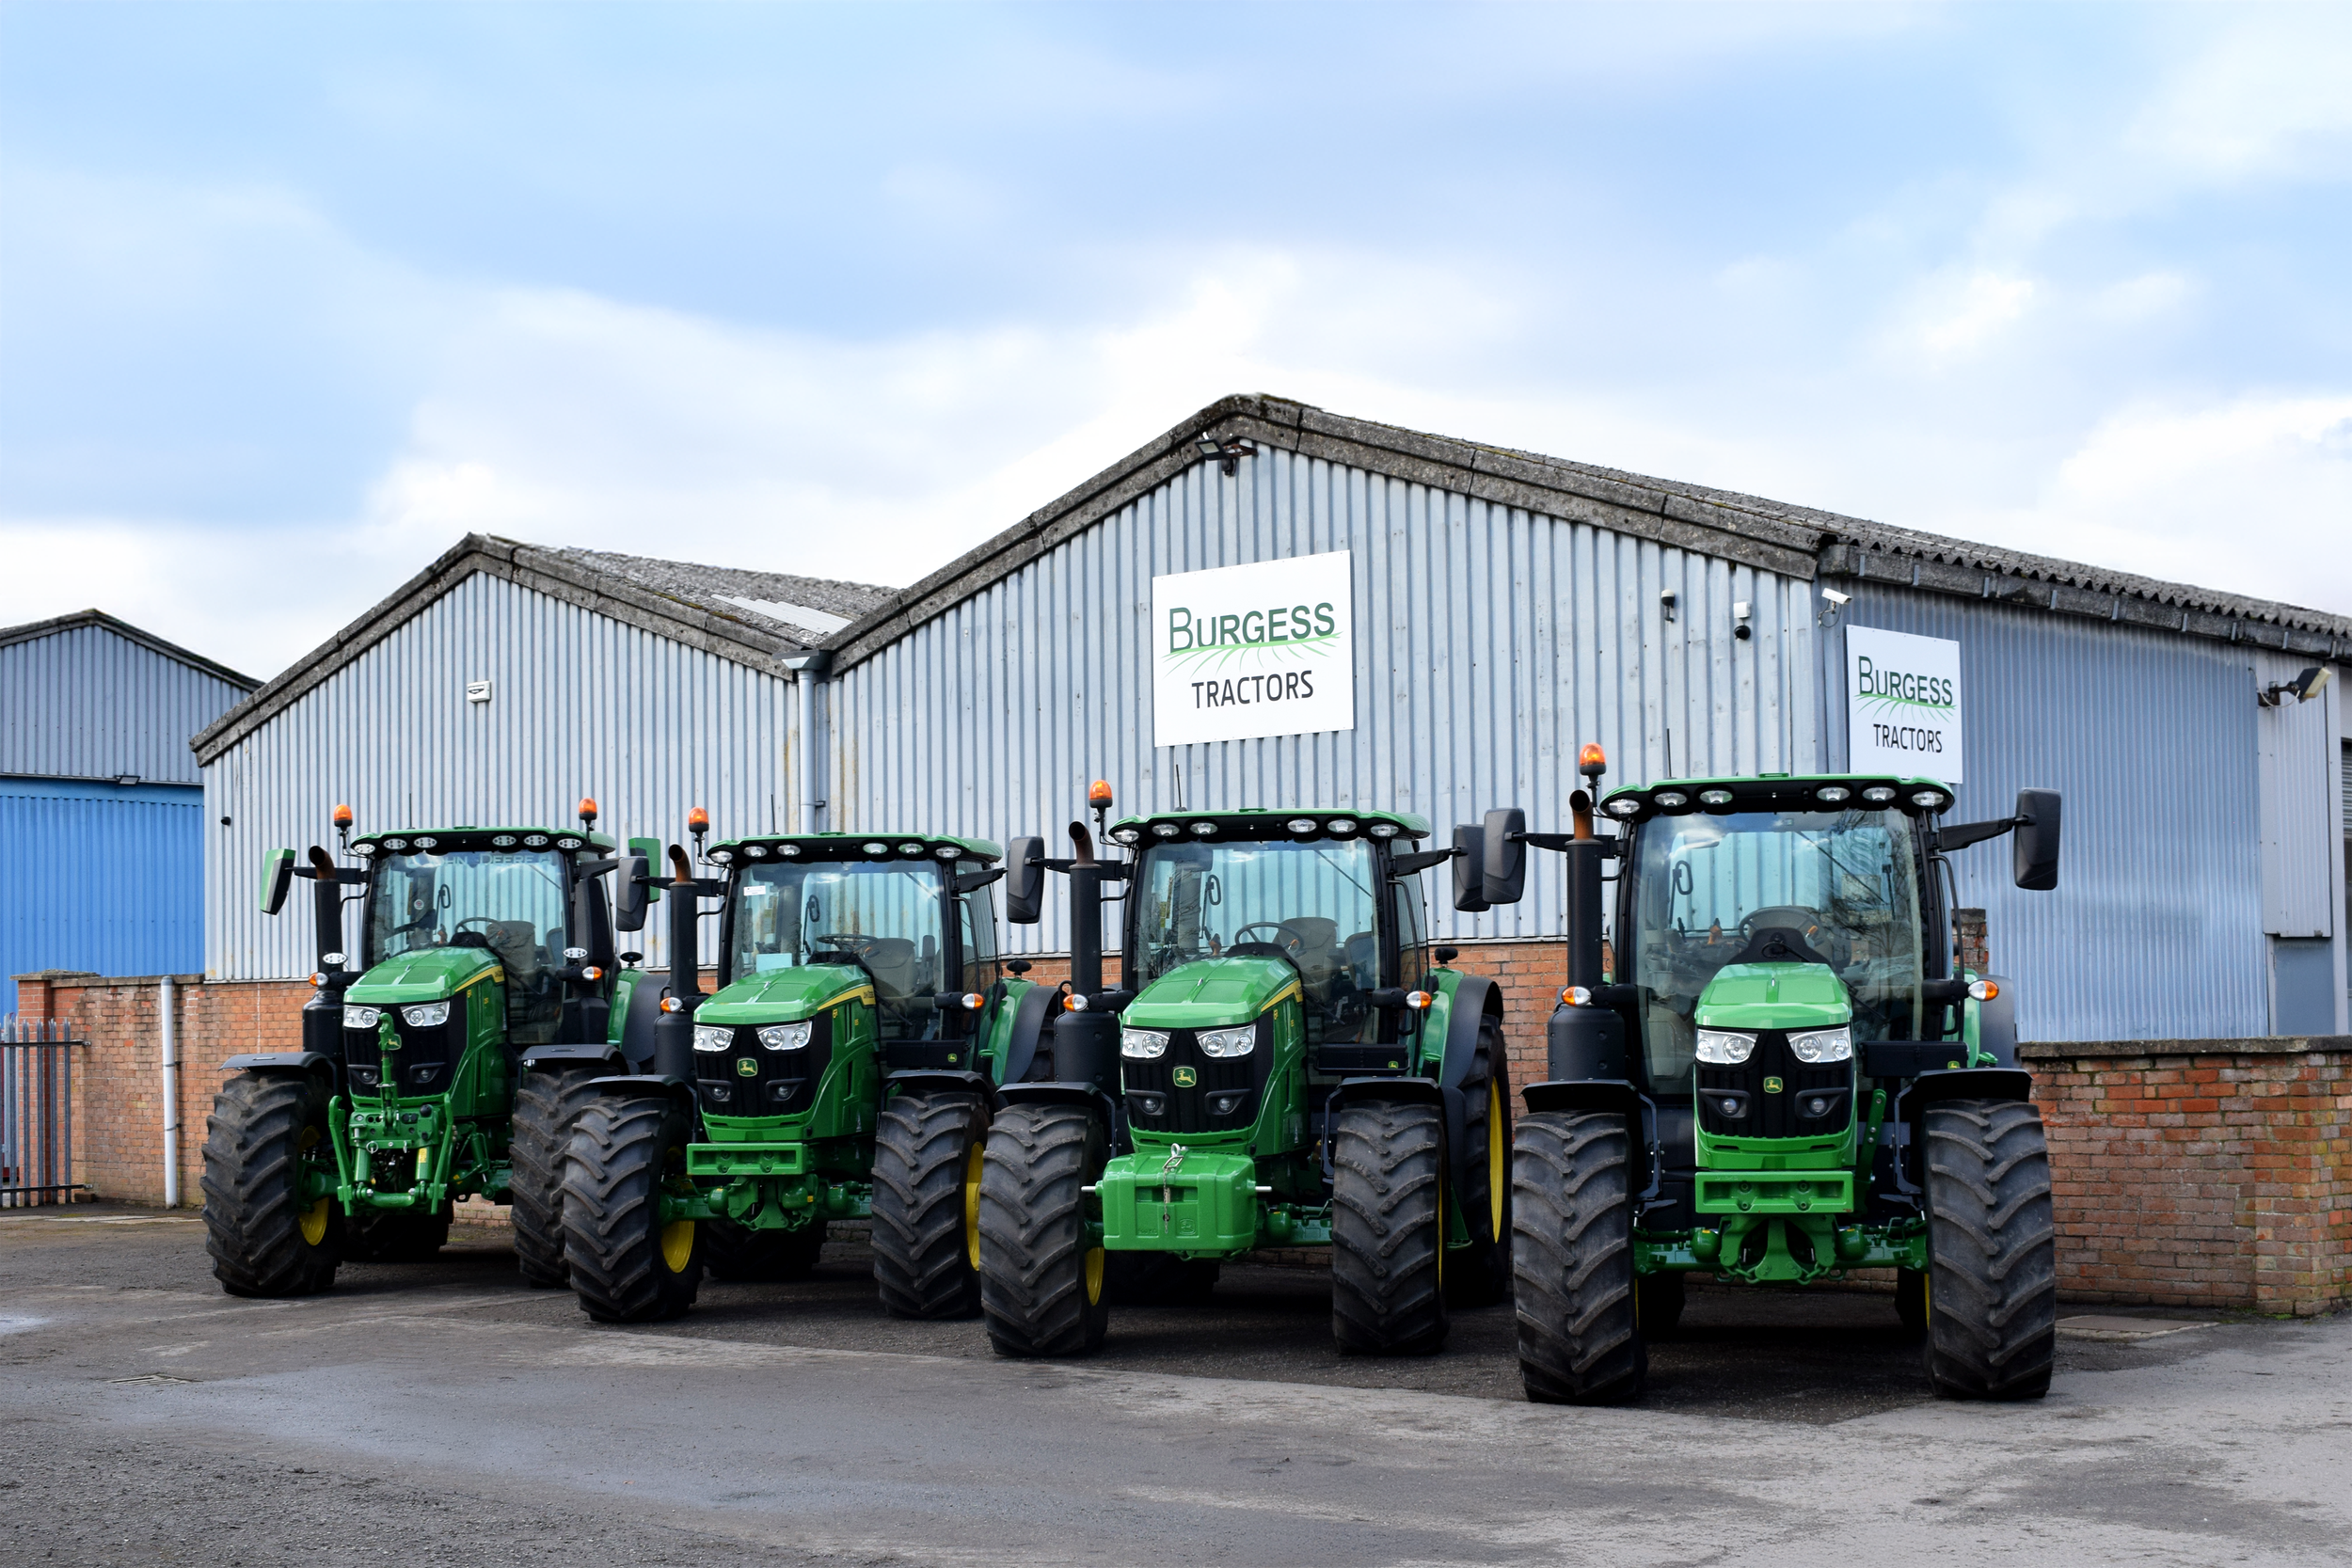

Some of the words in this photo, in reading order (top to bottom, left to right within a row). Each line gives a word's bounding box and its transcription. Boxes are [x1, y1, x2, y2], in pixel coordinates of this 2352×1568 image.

[1169, 602, 1335, 653] BURGESS
[1191, 670, 1314, 709] TRACTORS
[1858, 655, 1953, 706] BURGESS
[1873, 723, 1943, 753] TRACTORS
